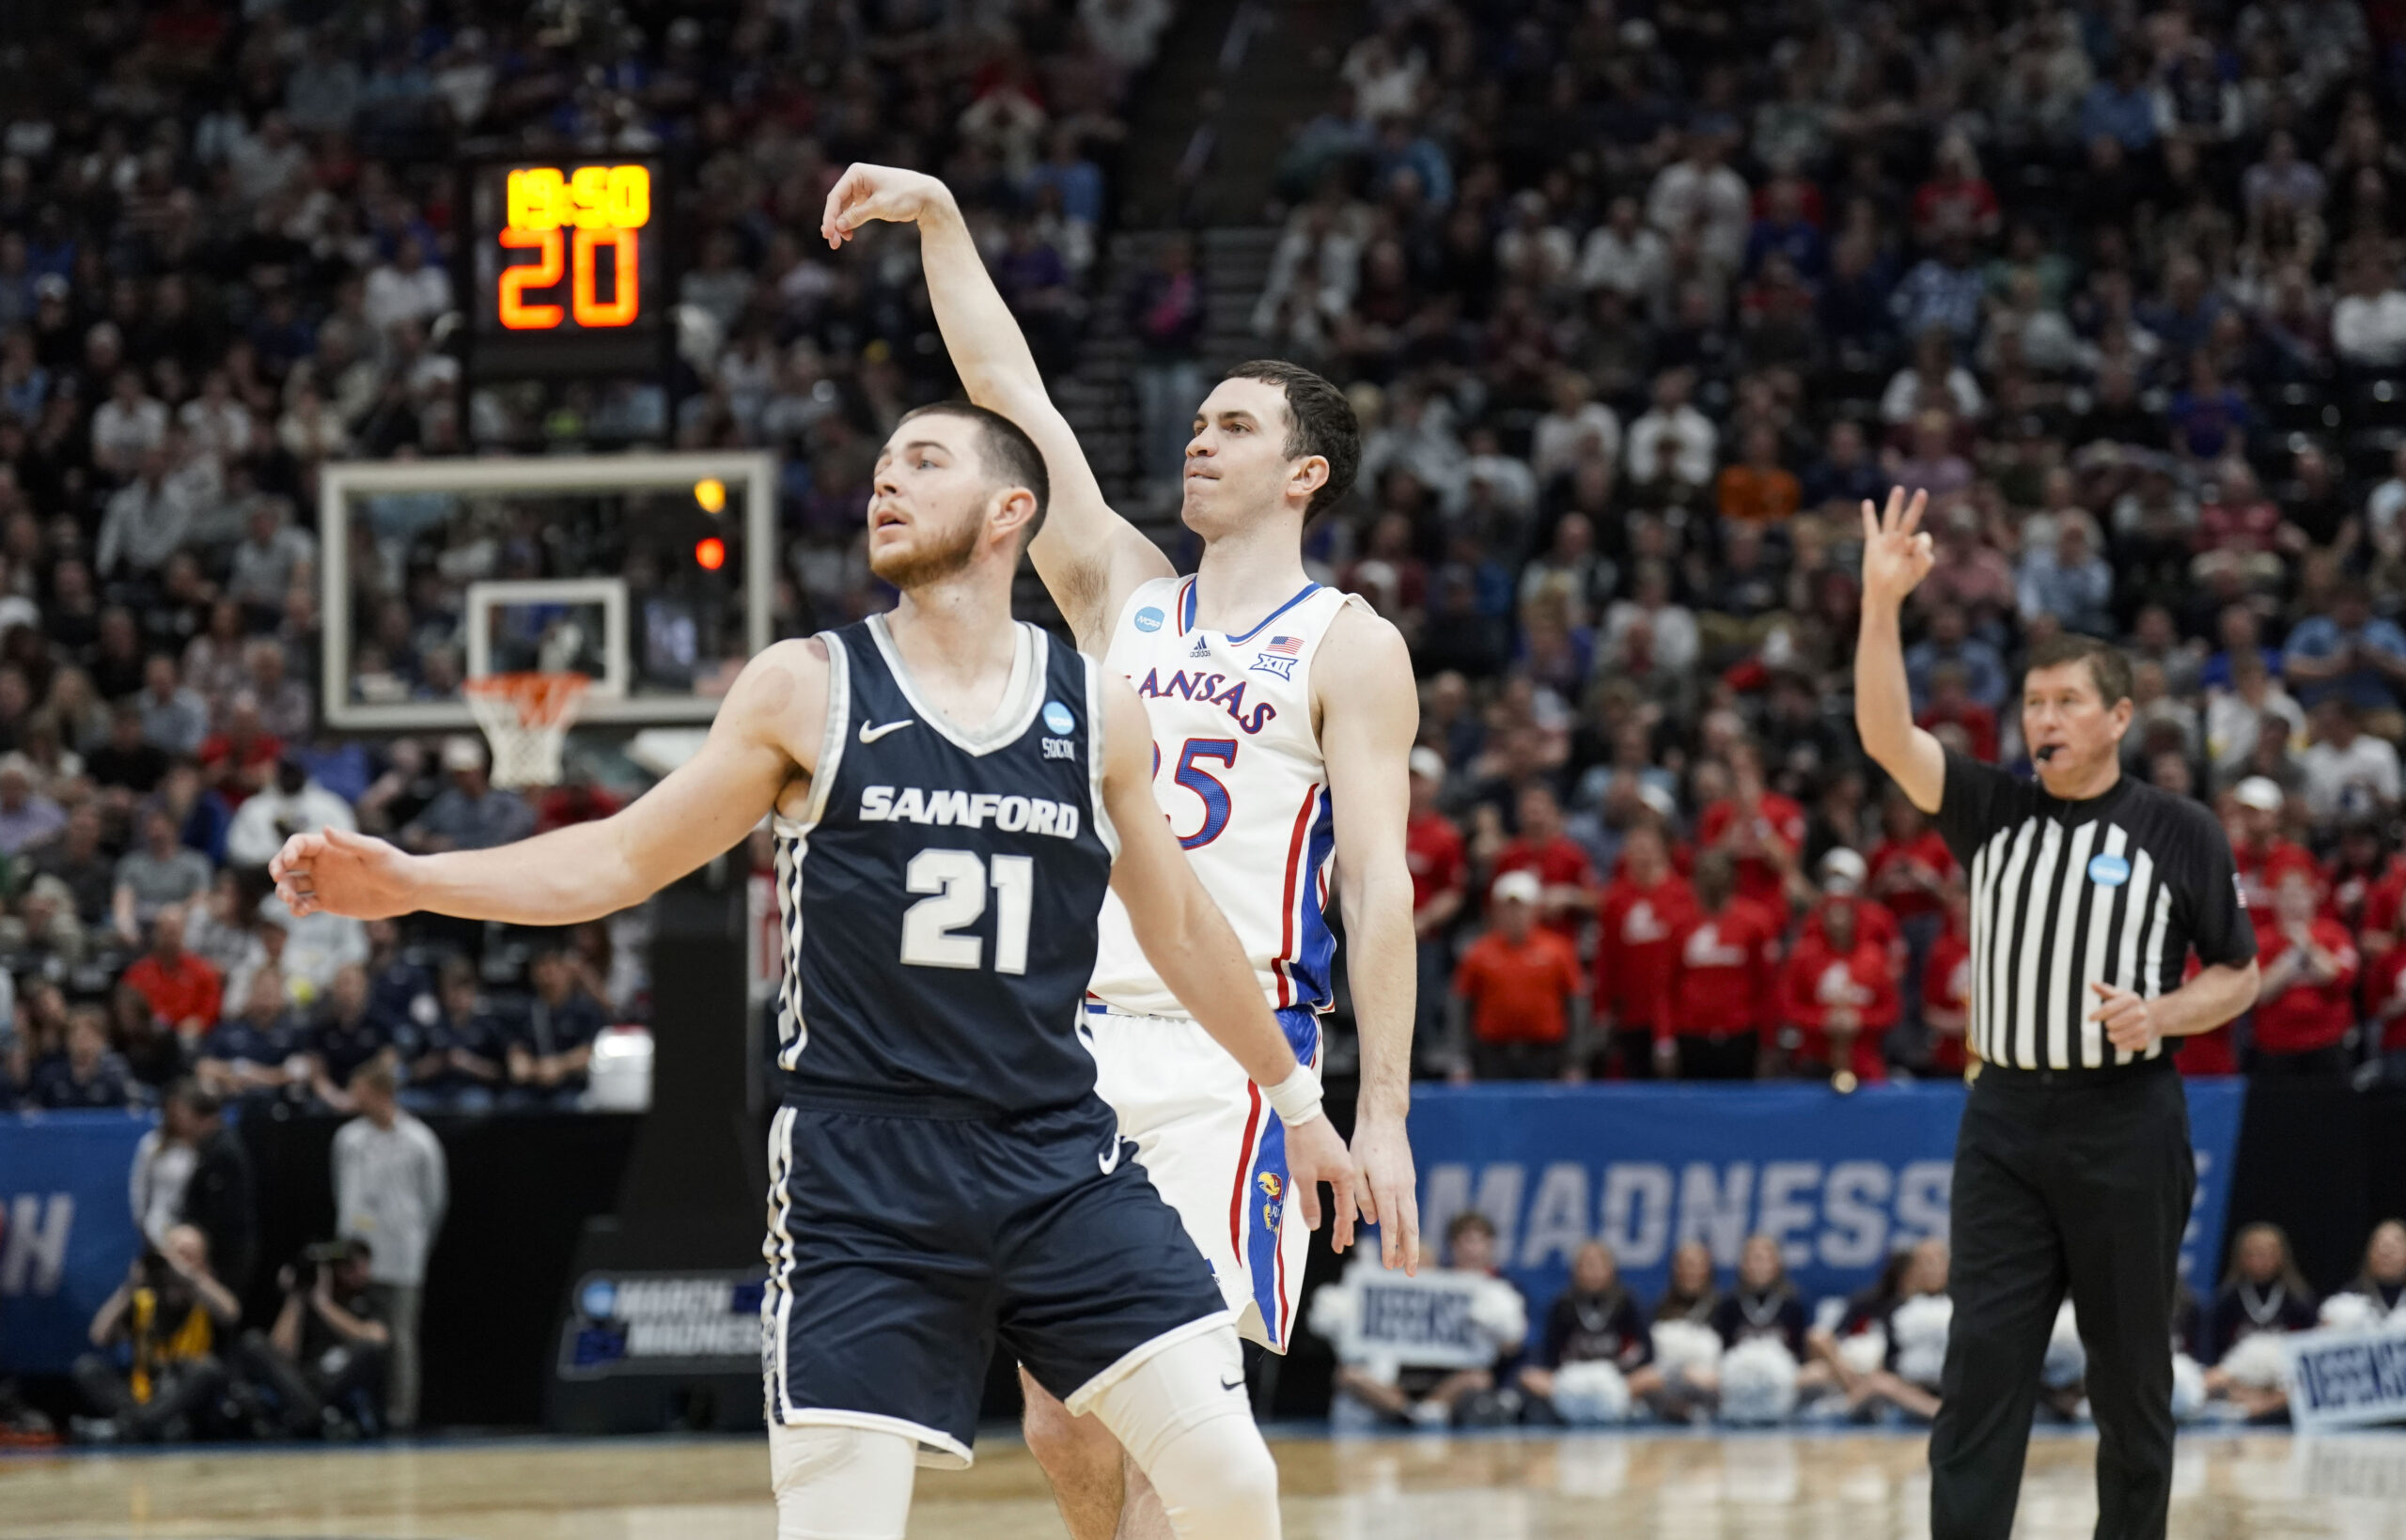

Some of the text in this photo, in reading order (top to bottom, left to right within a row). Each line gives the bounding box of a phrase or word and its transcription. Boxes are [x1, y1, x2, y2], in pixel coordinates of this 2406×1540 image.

[498, 227, 639, 330] 20
[1125, 667, 1276, 734] ANSAS
[1190, 649, 1211, 658] adidas
[859, 786, 1080, 840] SAMFORD
[1152, 738, 1238, 850] 5
[900, 848, 1033, 975] 21
[1419, 1161, 1953, 1268] MADNESS
